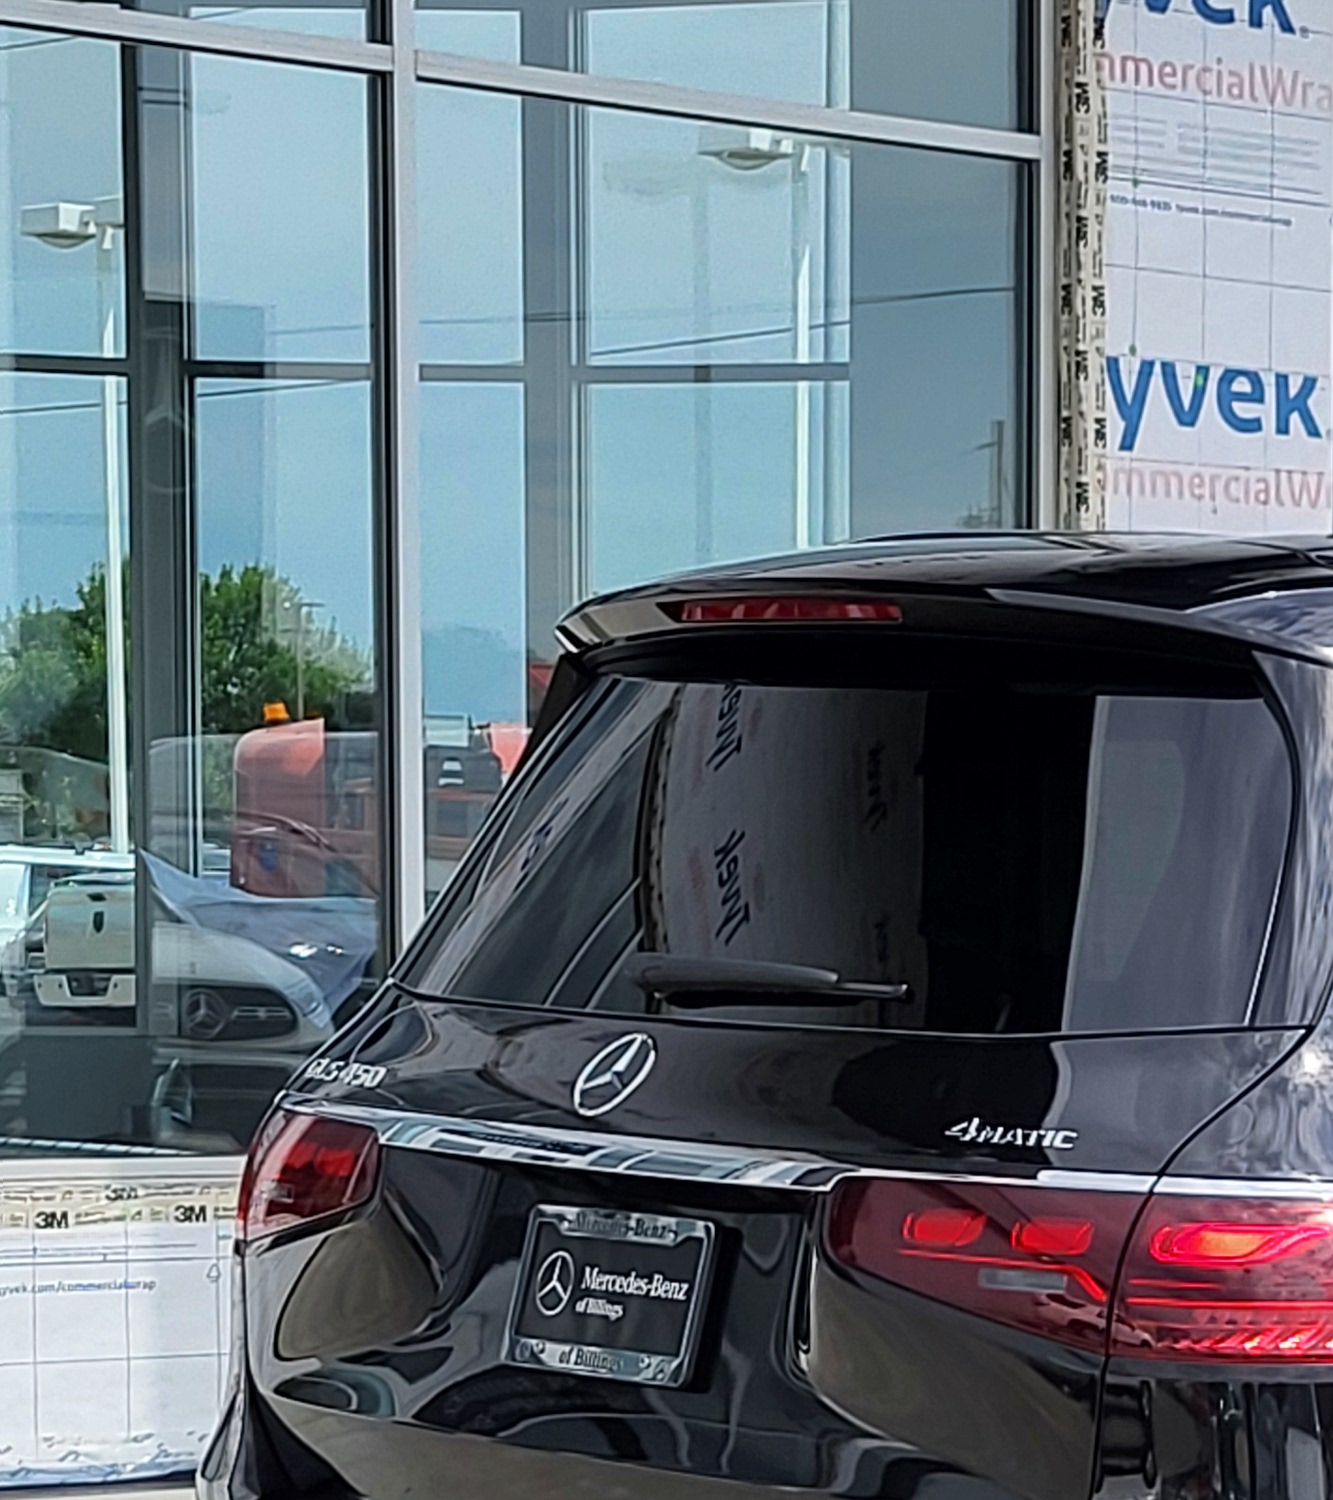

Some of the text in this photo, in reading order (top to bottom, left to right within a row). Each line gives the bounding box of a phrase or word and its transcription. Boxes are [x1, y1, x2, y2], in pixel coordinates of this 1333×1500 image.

[1075, 81, 1090, 115] 3M
[1094, 151, 1108, 184] 3M
[1075, 216, 1089, 248] 3M
[1061, 283, 1073, 317] 3M
[1091, 285, 1106, 317] 3M
[1106, 355, 1323, 451] yvek
[1061, 415, 1073, 448] 3M
[1094, 417, 1108, 449] 3M
[1075, 481, 1090, 514] 3M
[338, 1062, 388, 1088] 450
[944, 1116, 1079, 1149] 4MATIC
[33, 1210, 70, 1230] 3M
[173, 1204, 208, 1223] 3M
[580, 1265, 690, 1301] Mercedes-Benz
[558, 1345, 575, 1365] of
